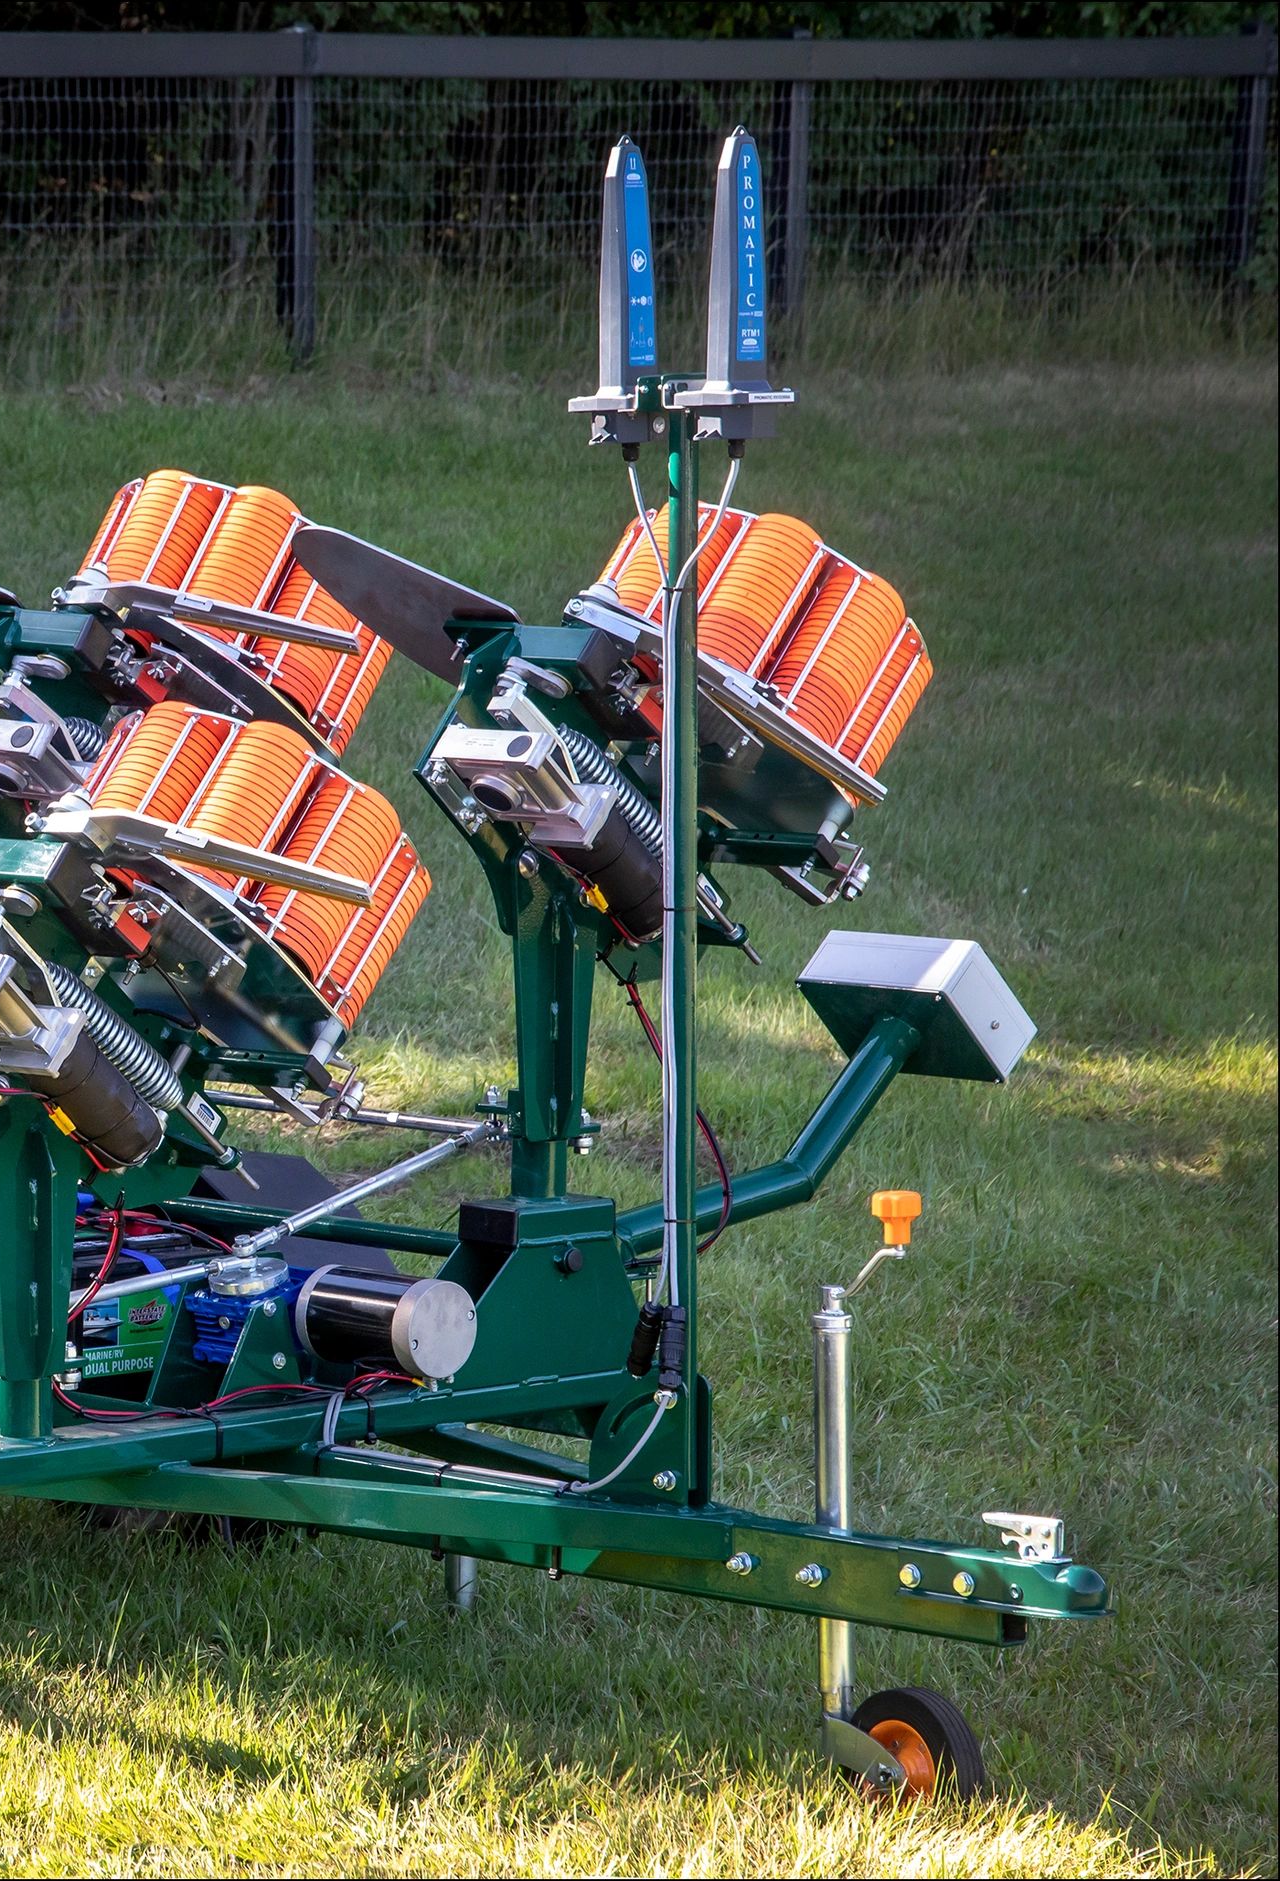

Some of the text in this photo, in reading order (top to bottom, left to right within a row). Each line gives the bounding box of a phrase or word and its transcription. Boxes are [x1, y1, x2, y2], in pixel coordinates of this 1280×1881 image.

[743, 155, 756, 307] PROMATIC
[741, 328, 760, 337] RTM1
[85, 1349, 124, 1361] MARINE/RV
[85, 1357, 153, 1376] DUAL PURPOSE
